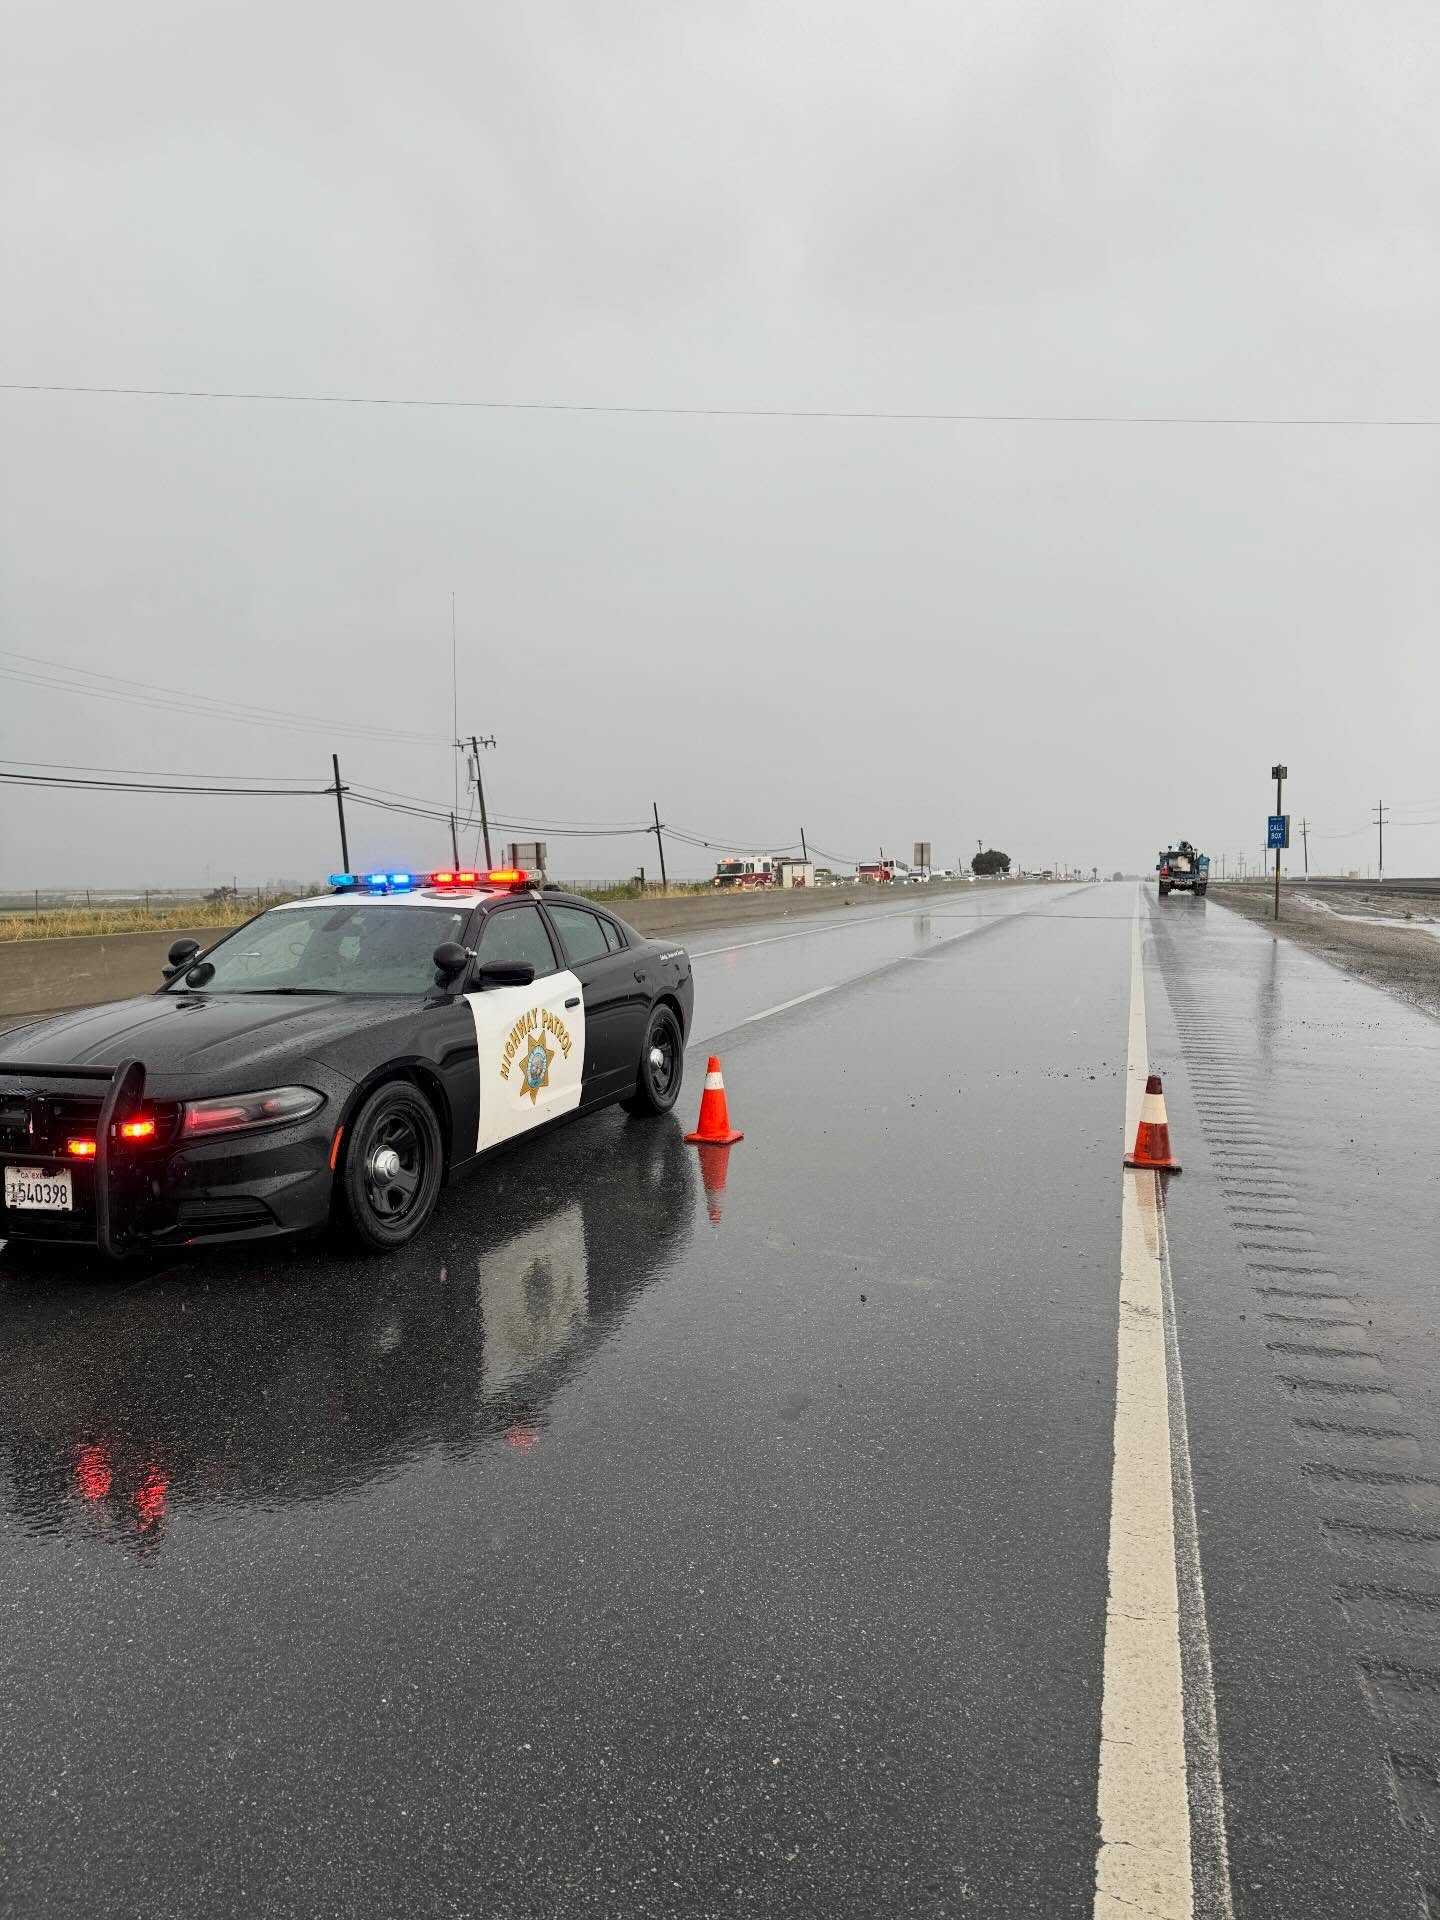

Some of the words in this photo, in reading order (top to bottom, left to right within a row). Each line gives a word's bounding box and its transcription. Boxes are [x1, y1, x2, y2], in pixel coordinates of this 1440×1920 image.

[500, 1008, 538, 1080] HIGHWAY
[541, 1008, 573, 1060] PATROL
[10, 1182, 68, 1204] 1540398
